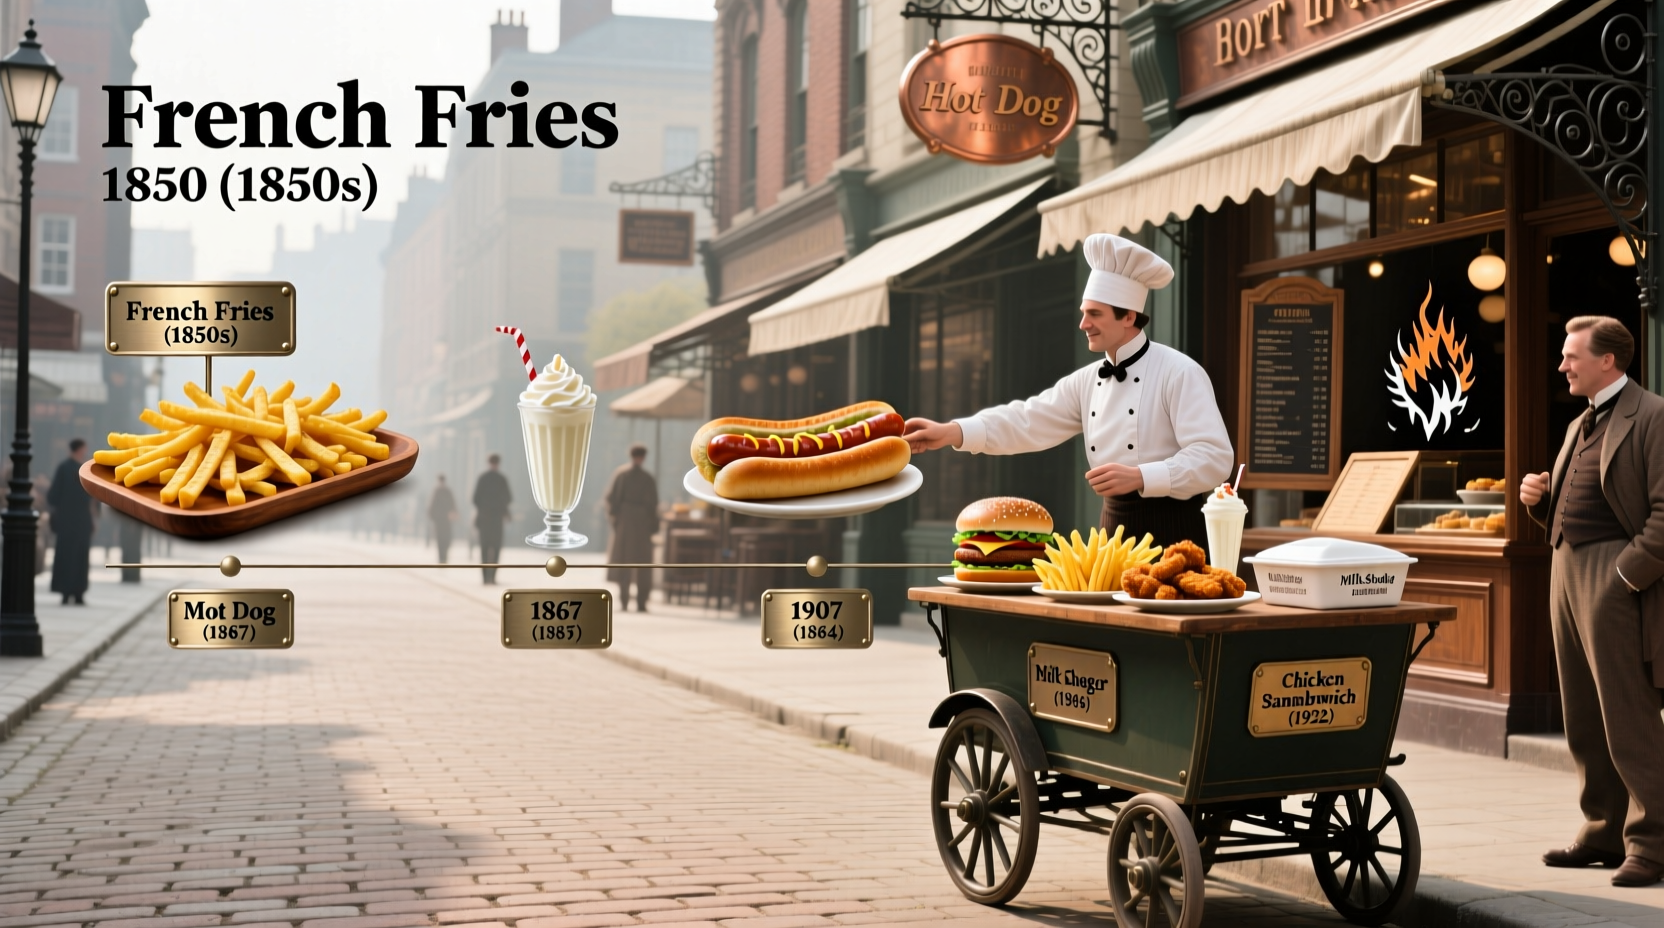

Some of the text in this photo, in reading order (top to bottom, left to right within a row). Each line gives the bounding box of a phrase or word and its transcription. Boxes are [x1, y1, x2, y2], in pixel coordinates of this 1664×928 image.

[919, 80, 1063, 126] Hot Dog
[126, 300, 274, 321] French Fries
[164, 325, 238, 347] (1850s)
[184, 601, 276, 626] Mot Dog
[530, 600, 583, 620] 1867
[791, 600, 843, 620] 1907
[203, 624, 256, 642] (1867)
[793, 624, 844, 642] (1864)
[1288, 707, 1335, 728] (1922)
